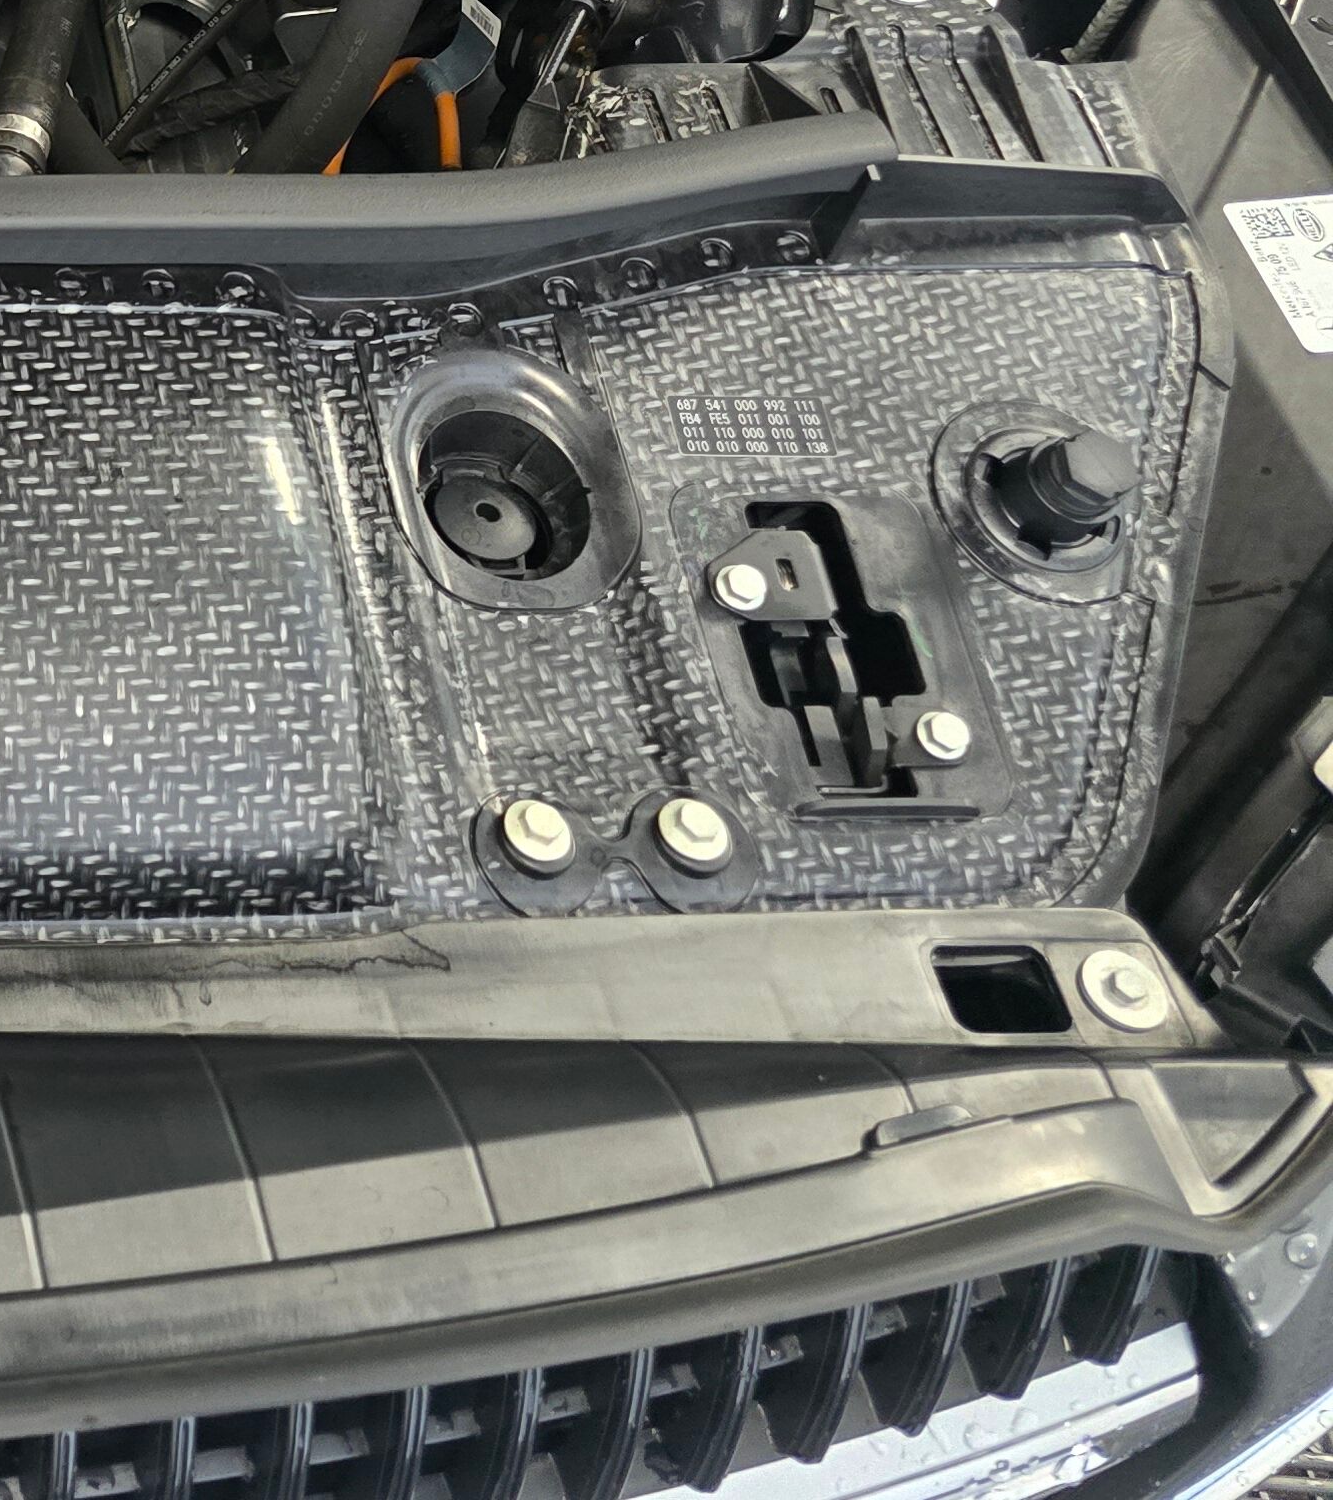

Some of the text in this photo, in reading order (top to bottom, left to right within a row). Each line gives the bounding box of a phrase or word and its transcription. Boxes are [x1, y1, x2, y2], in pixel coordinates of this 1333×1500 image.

[676, 399, 816, 412] 687 541 000 992 111
[679, 413, 821, 426] FB4 FE5 011 001 100
[683, 427, 824, 440] 011 110 000 010 101
[686, 441, 829, 453] 010 010 000 110 138
